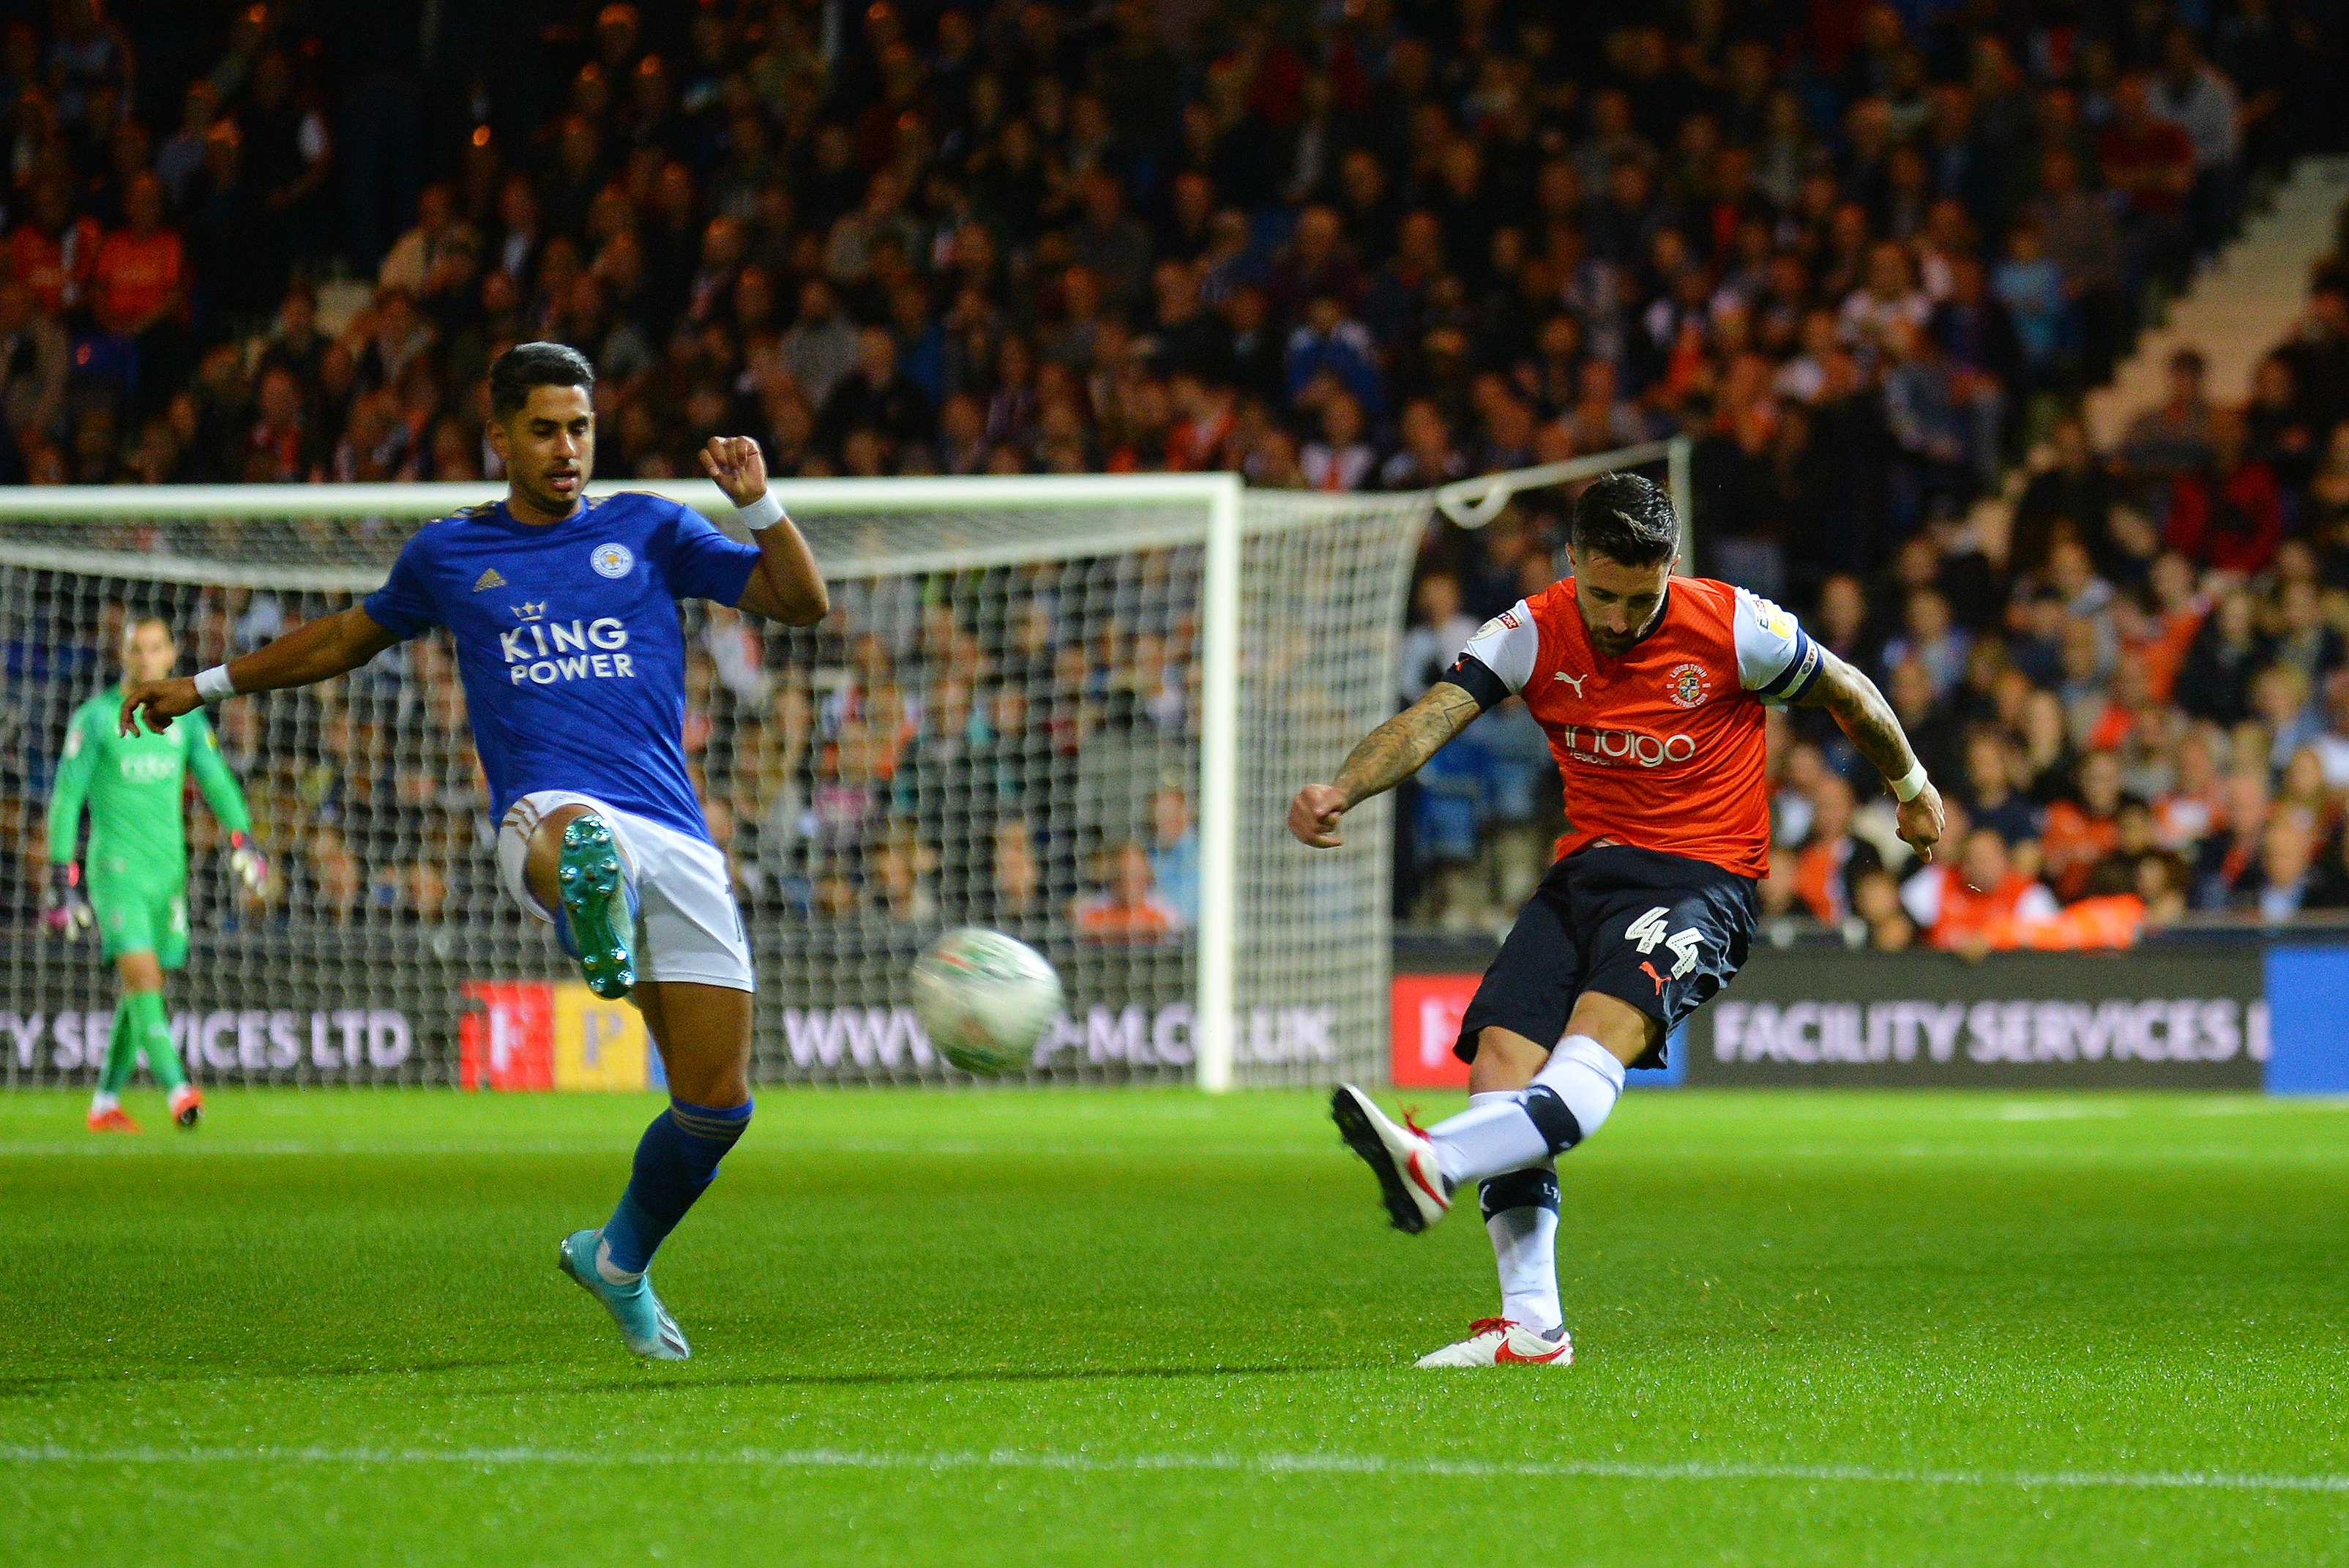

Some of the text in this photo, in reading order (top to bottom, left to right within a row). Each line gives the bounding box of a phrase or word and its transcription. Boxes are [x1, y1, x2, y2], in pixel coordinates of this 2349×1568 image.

[498, 617, 628, 663] KING
[510, 653, 635, 686] POWER
[1624, 906, 1705, 981] 44
[52, 1009, 299, 1069] SEICES
[310, 1009, 412, 1069] LTD
[583, 1007, 624, 1069] P
[1713, 1000, 1968, 1063] FACILITY
[1967, 998, 2241, 1063] SERVICES
